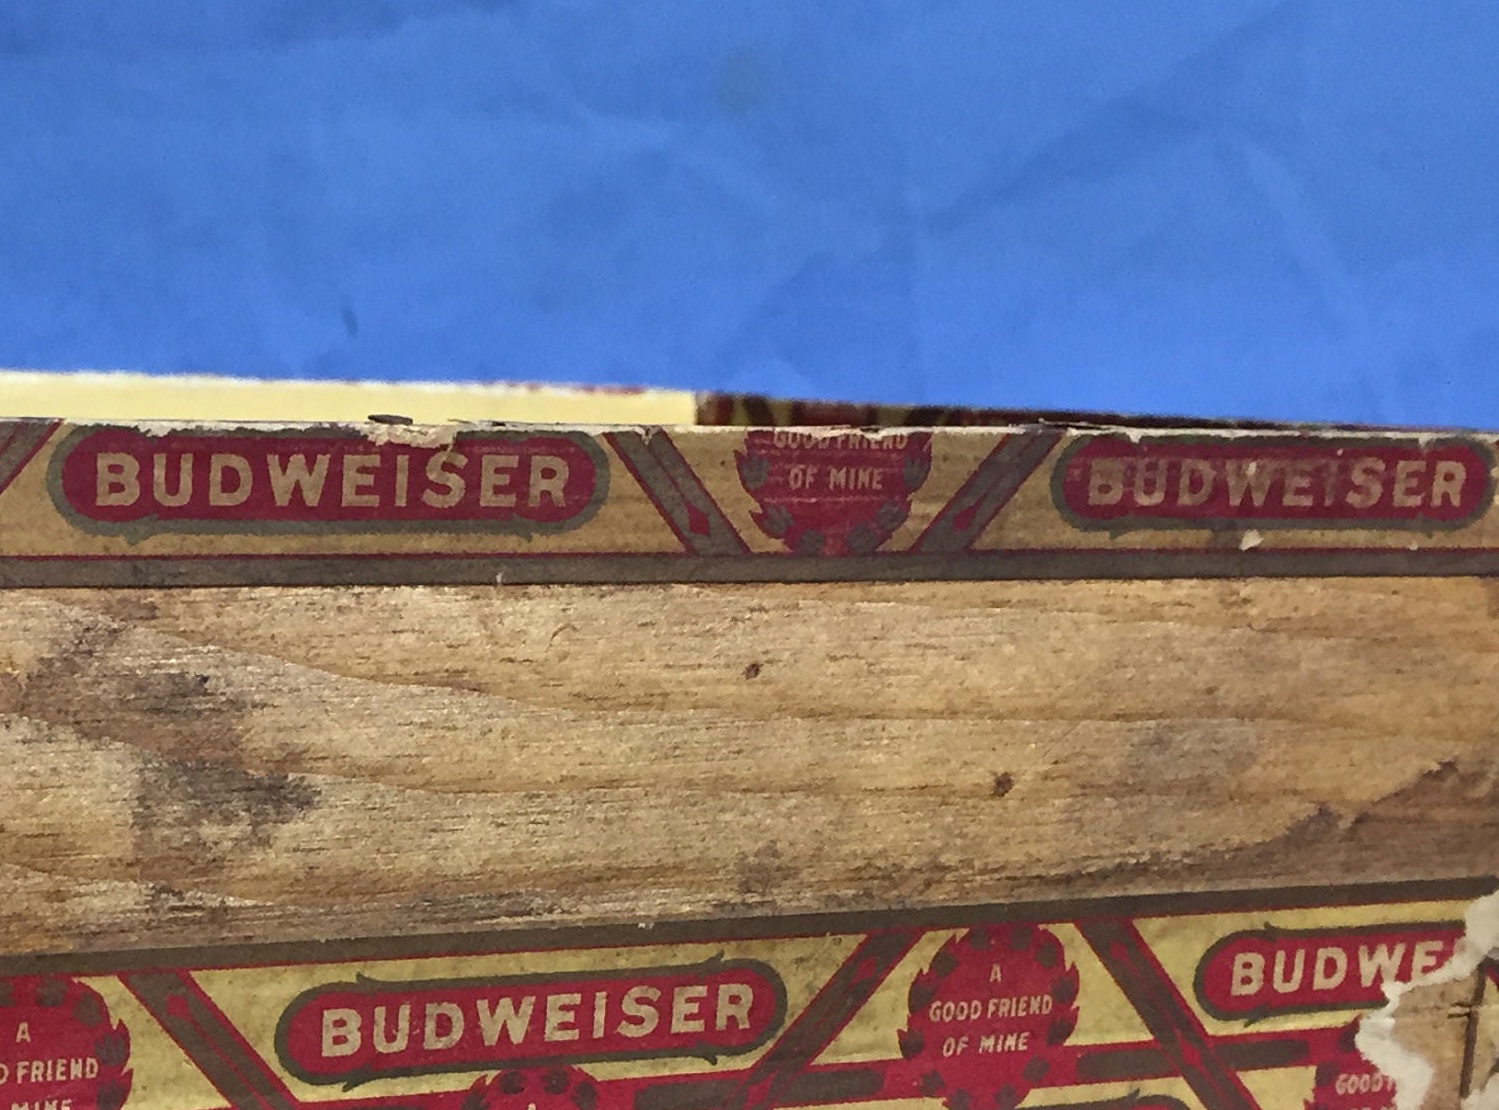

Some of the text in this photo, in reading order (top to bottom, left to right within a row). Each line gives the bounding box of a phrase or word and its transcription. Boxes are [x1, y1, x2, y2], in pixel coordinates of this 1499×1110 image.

[95, 452, 567, 509] BUDWEISER
[788, 465, 883, 490] OF MINE
[1088, 456, 1466, 509] BUDWEISER
[990, 963, 1002, 984] A
[1230, 940, 1464, 996] BUDWE
[321, 983, 754, 1058] BUDWEISER
[929, 994, 1053, 1023] GOOD FRIEND
[15, 1022, 31, 1043] A
[942, 1031, 1029, 1057] OF MINE
[16, 1056, 99, 1085] FRIEND
